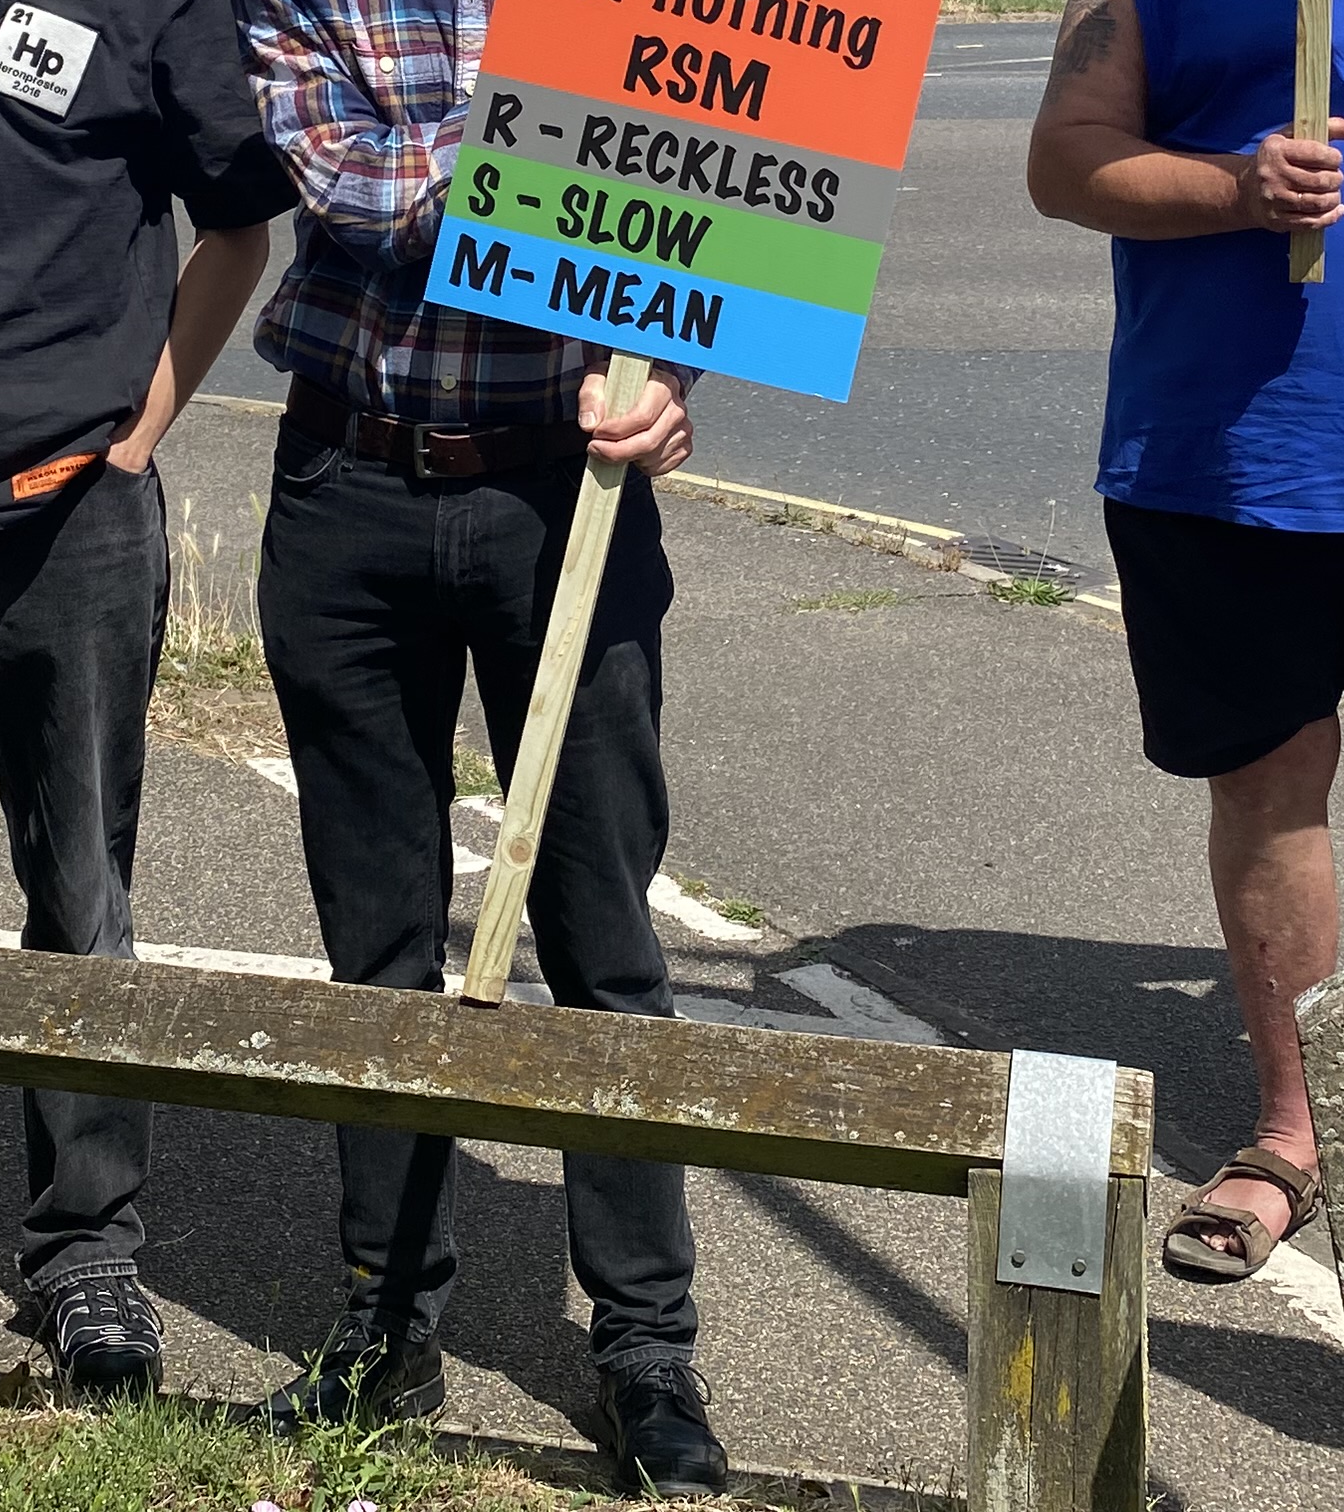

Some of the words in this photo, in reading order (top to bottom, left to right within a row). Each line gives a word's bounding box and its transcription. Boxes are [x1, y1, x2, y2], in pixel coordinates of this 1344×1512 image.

[10, 8, 34, 26] 21
[12, 31, 64, 78] Hp
[623, 35, 770, 121] RSM
[576, 114, 839, 224] RECKLESS
[556, 184, 712, 267] SLOW
[548, 258, 723, 349] MEAN
